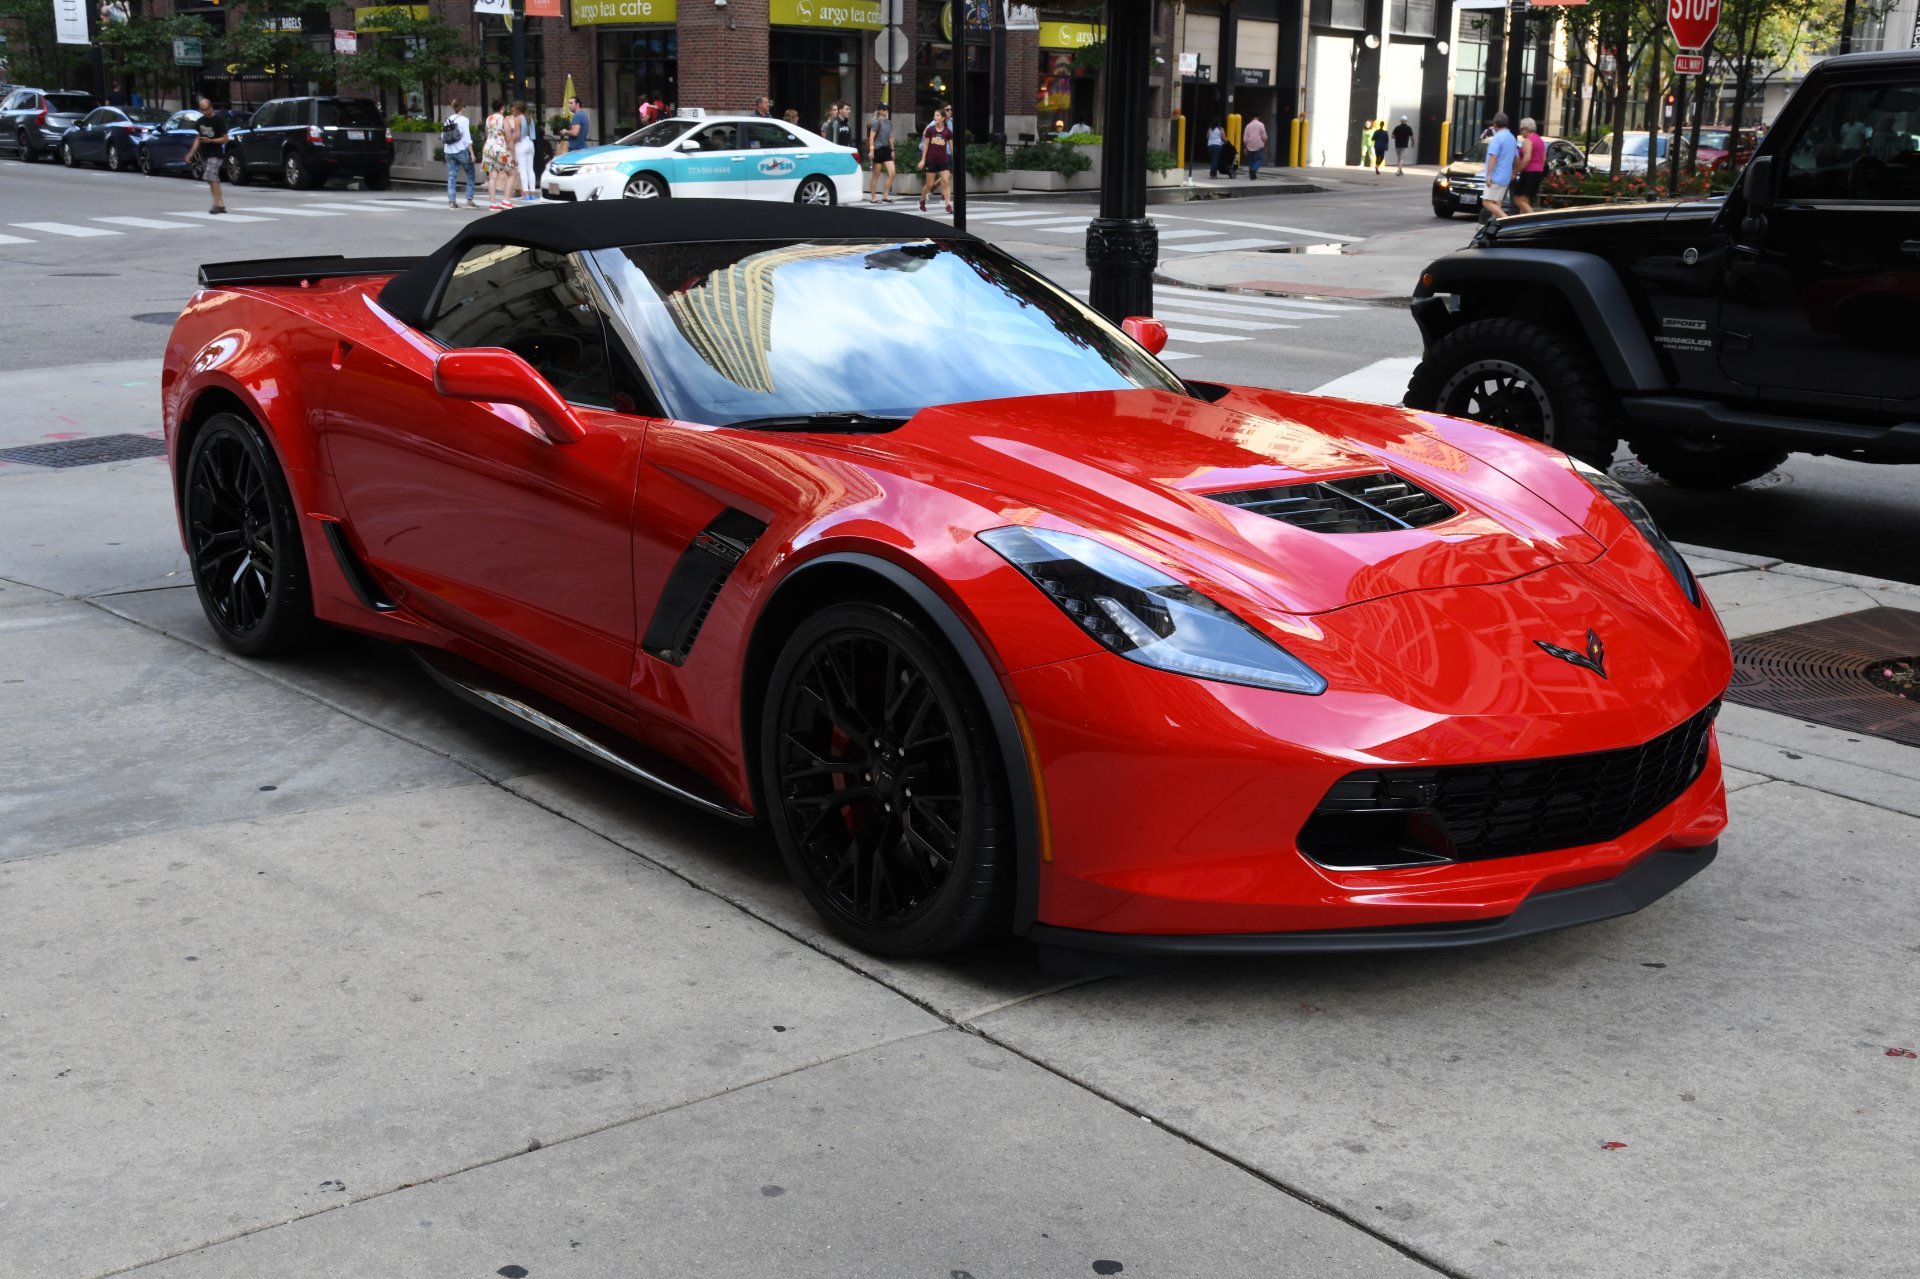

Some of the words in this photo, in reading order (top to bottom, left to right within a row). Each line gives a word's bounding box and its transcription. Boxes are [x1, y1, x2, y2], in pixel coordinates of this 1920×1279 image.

[600, 2, 616, 16] tea
[619, 0, 652, 16] cafe
[1671, 0, 1718, 20] STOP
[820, 6, 848, 25] argo
[851, 6, 865, 22] tea
[281, 17, 302, 30] BAGELS
[1677, 59, 1688, 70] ALL
[1689, 60, 1701, 70] WAY
[1664, 319, 1705, 329] SPORT
[1654, 336, 1712, 346] WRANGLER
